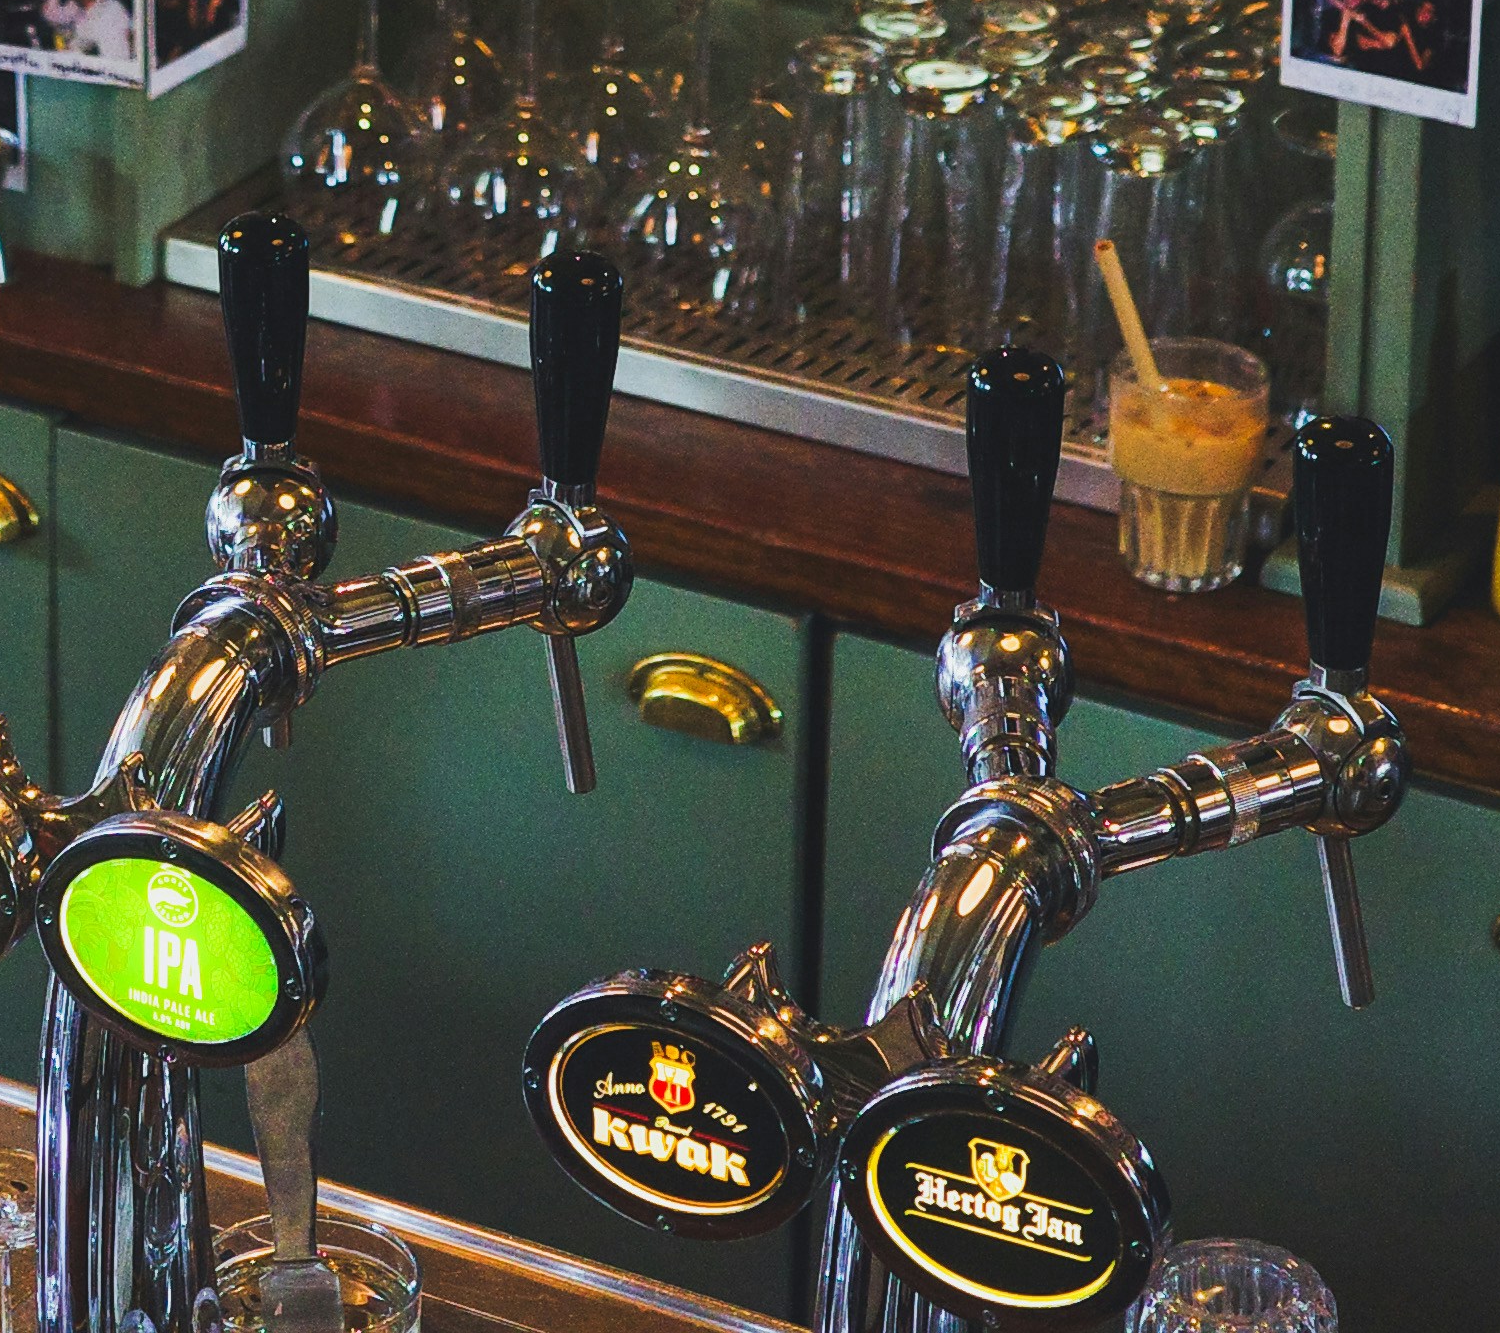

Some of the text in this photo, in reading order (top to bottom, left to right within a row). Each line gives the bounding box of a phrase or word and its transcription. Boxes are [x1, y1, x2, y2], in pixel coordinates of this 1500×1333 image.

[143, 925, 203, 1001] IPA
[128, 987, 217, 1027] INDIA PALE ALE
[592, 1070, 646, 1100] Anno
[702, 1101, 750, 1134] 1791
[913, 1170, 1085, 1246] Hertog Jan
